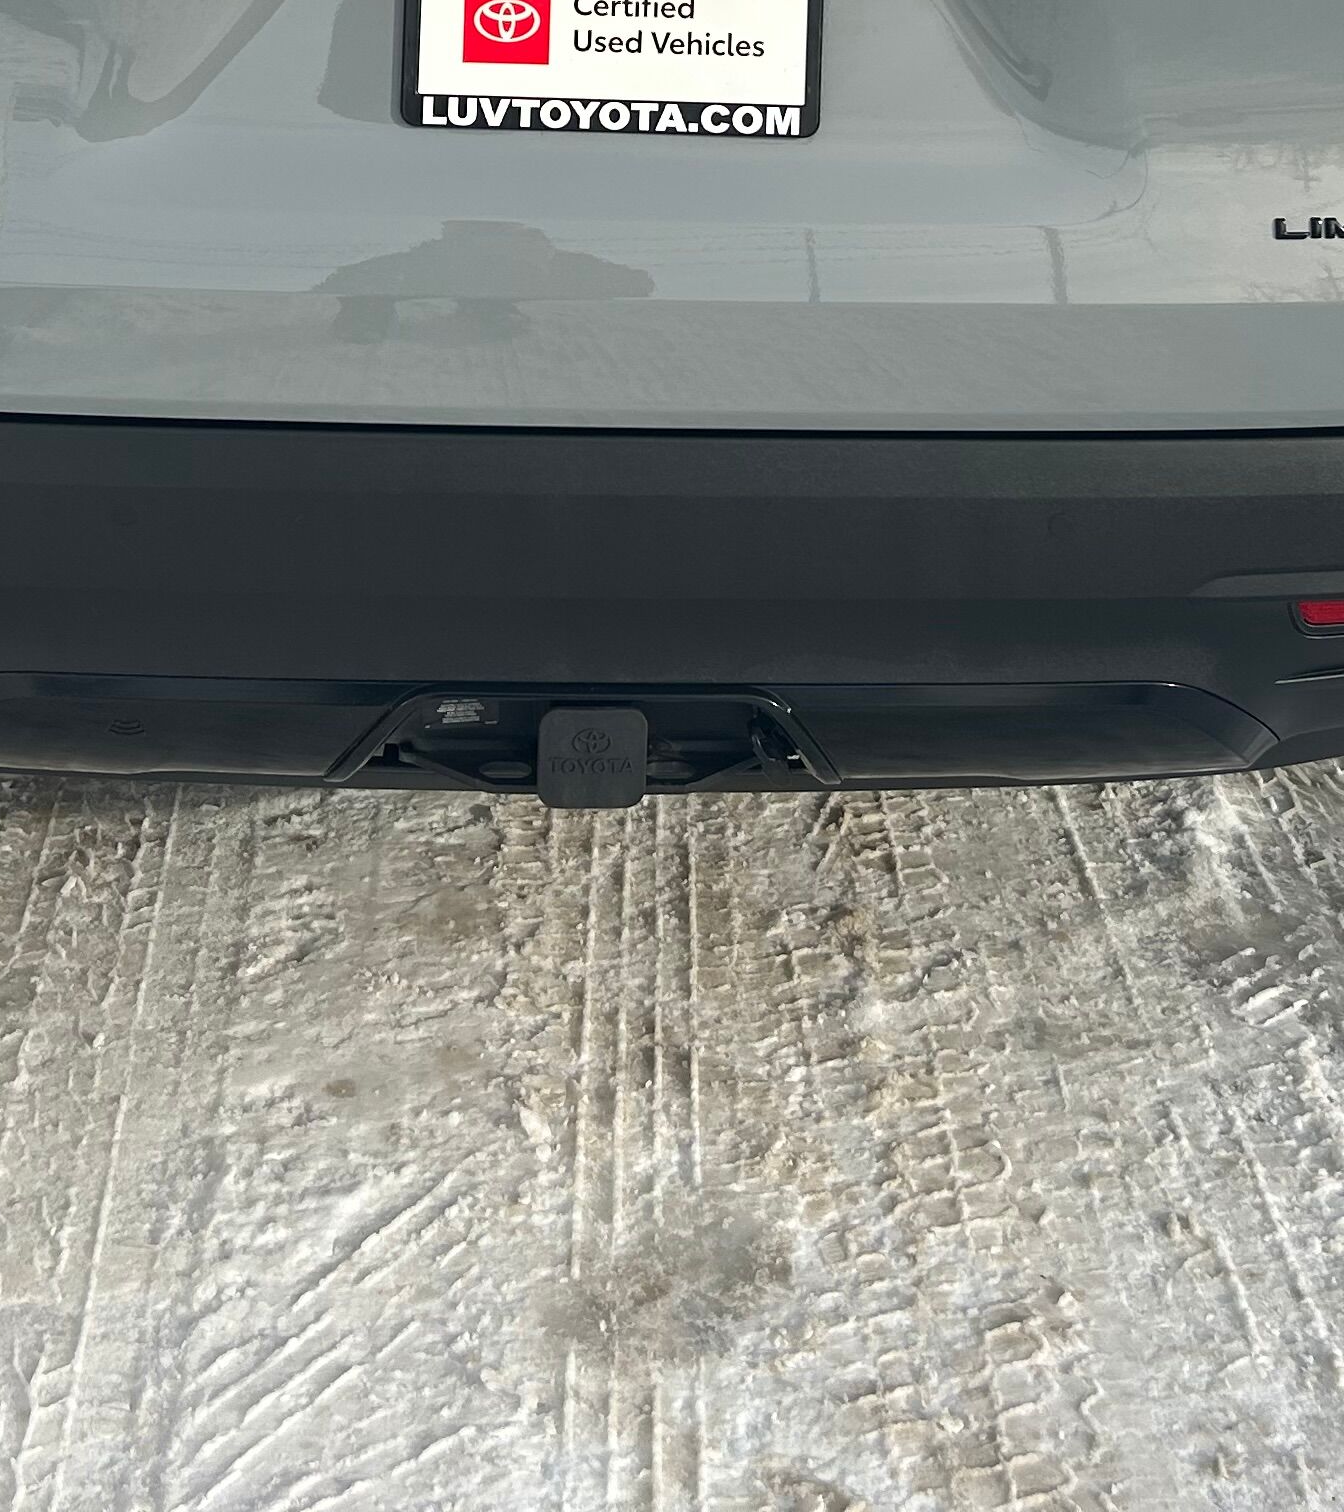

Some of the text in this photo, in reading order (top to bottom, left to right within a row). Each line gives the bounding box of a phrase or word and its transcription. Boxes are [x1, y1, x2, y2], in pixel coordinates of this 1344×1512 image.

[573, 30, 765, 57] Used Vehicles
[422, 96, 801, 136] LUVTOYOTA.COM
[549, 756, 633, 775] TOYOTA
